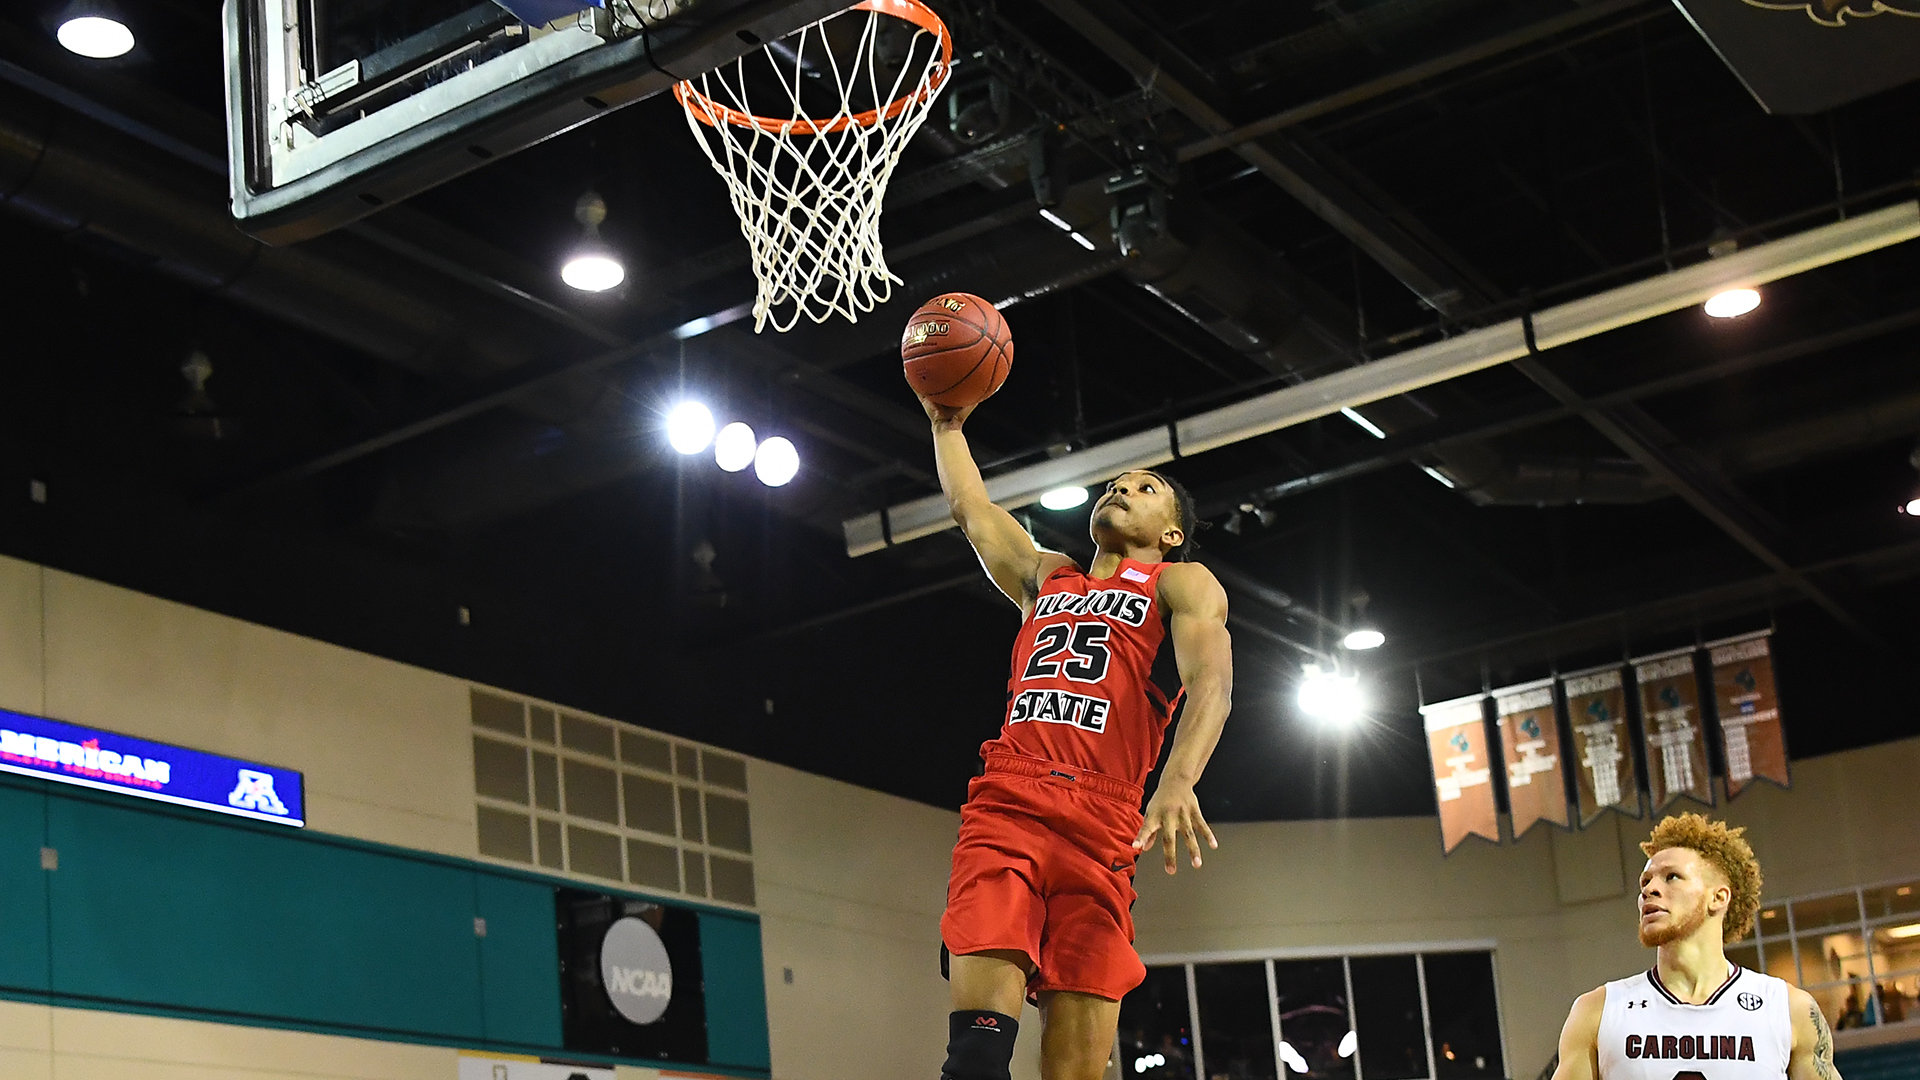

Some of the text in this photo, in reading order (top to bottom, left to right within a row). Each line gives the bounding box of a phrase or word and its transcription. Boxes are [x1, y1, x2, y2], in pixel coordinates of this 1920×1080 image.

[1021, 622, 1111, 684] 25
[1009, 689, 1110, 733] STATE
[0, 728, 170, 784] MERICAN
[611, 966, 672, 999] NCAA
[1739, 992, 1762, 1010] SEC
[1626, 1035, 1756, 1061] CAROLINA
